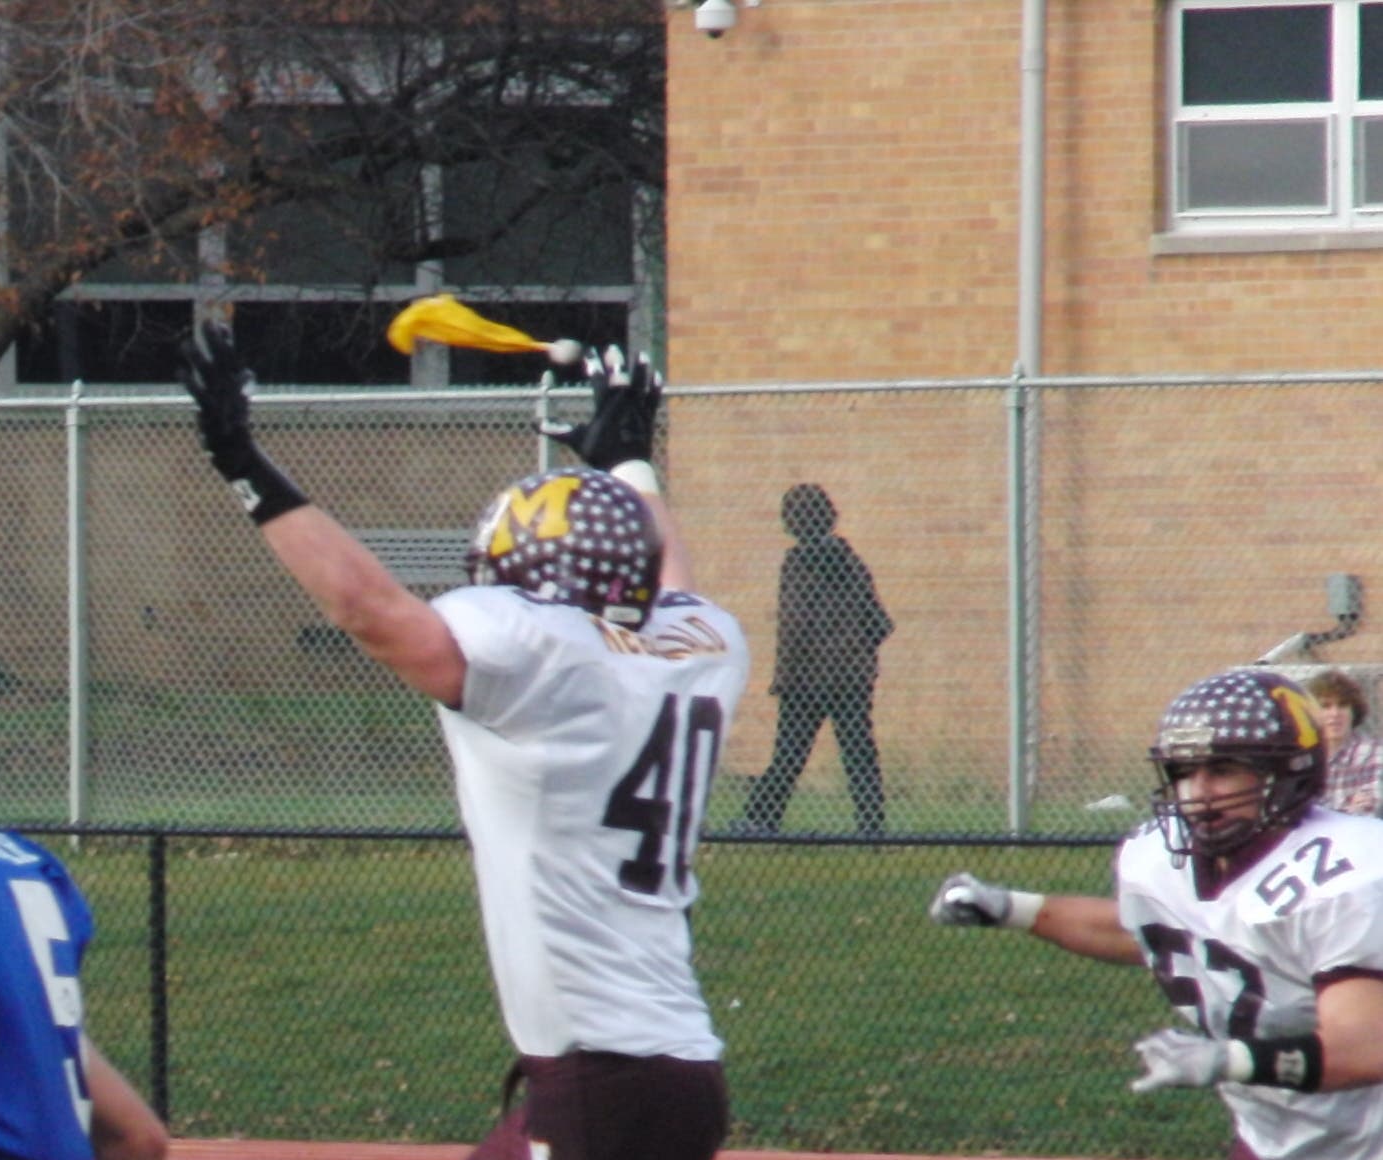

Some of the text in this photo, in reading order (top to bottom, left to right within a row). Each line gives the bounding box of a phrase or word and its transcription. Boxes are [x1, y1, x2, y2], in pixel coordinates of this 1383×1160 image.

[488, 475, 582, 557] M
[602, 693, 723, 896] 40
[1255, 835, 1354, 918] 52
